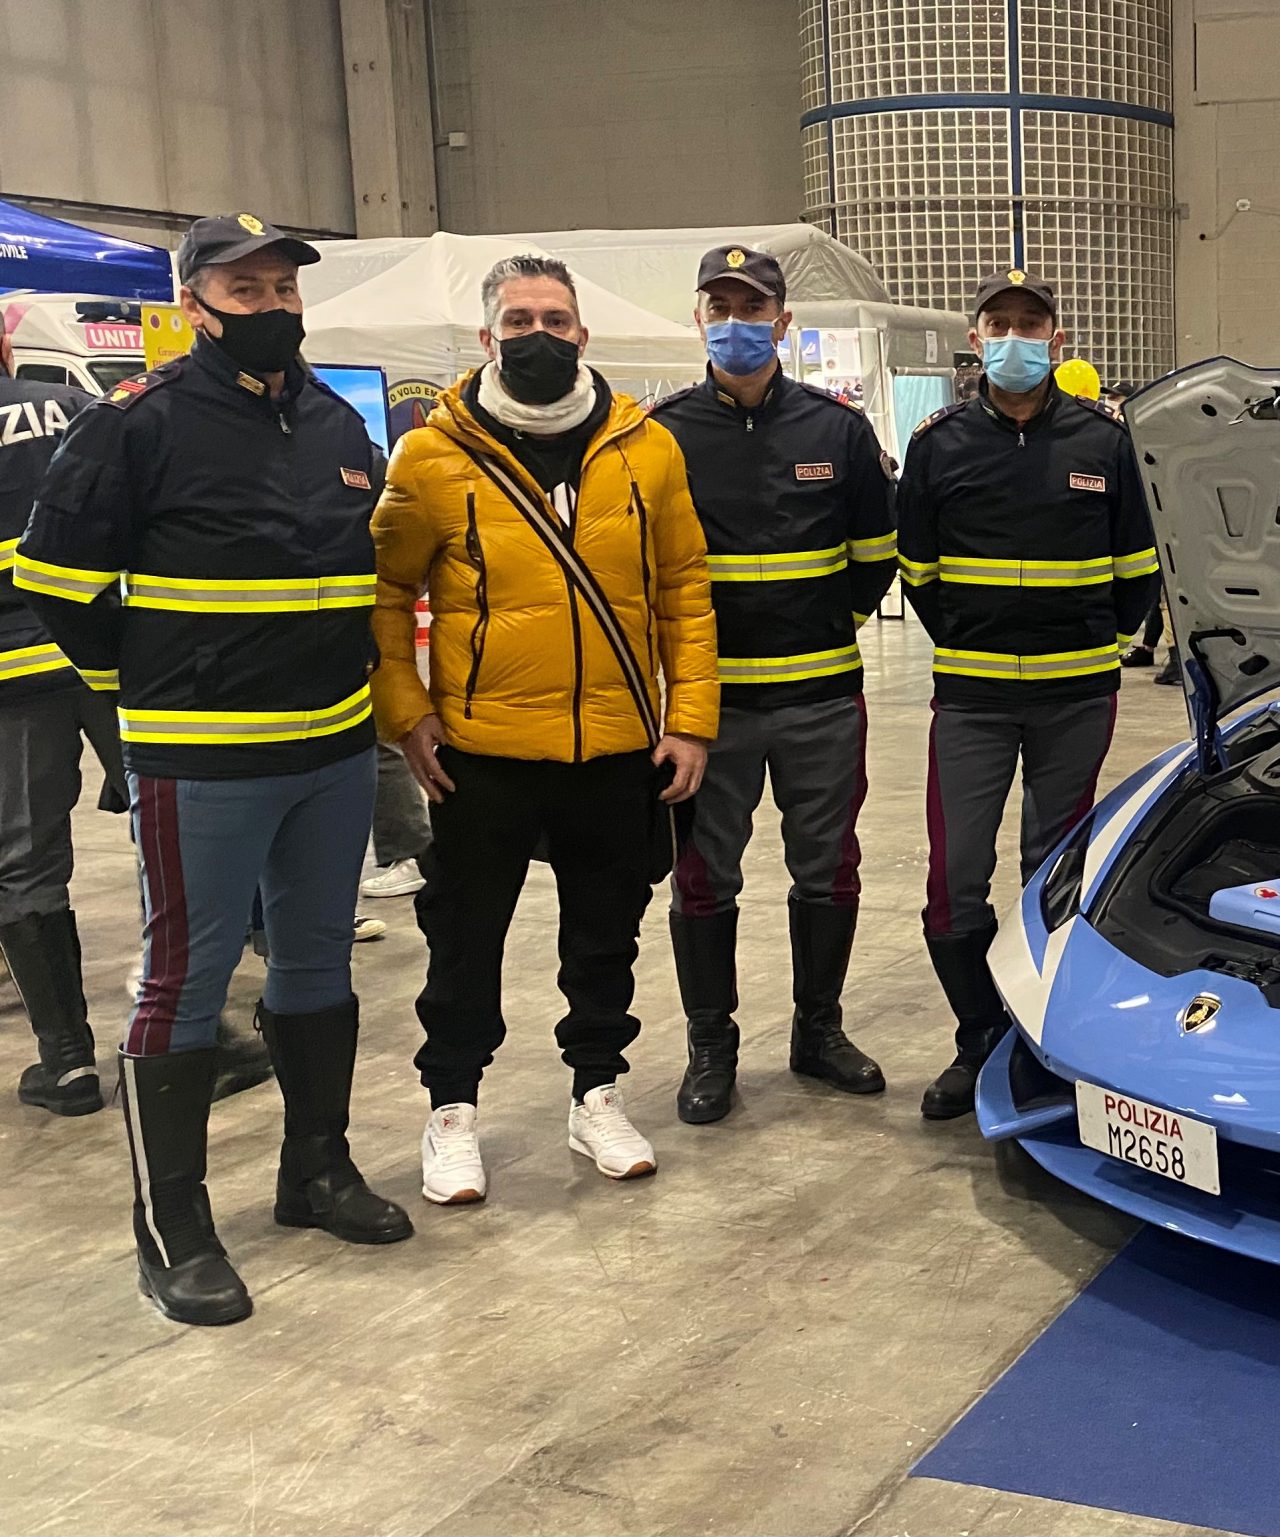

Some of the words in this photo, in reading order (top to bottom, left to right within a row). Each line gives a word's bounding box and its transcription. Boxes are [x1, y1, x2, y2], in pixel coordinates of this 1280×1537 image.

[89, 328, 144, 348] UNIT
[397, 386, 421, 397] VOLO
[797, 466, 831, 478] POLIZIA
[1072, 476, 1103, 489] POLIZIA
[1104, 1093, 1184, 1141] POLIZIA
[1108, 1122, 1185, 1180] M2658
